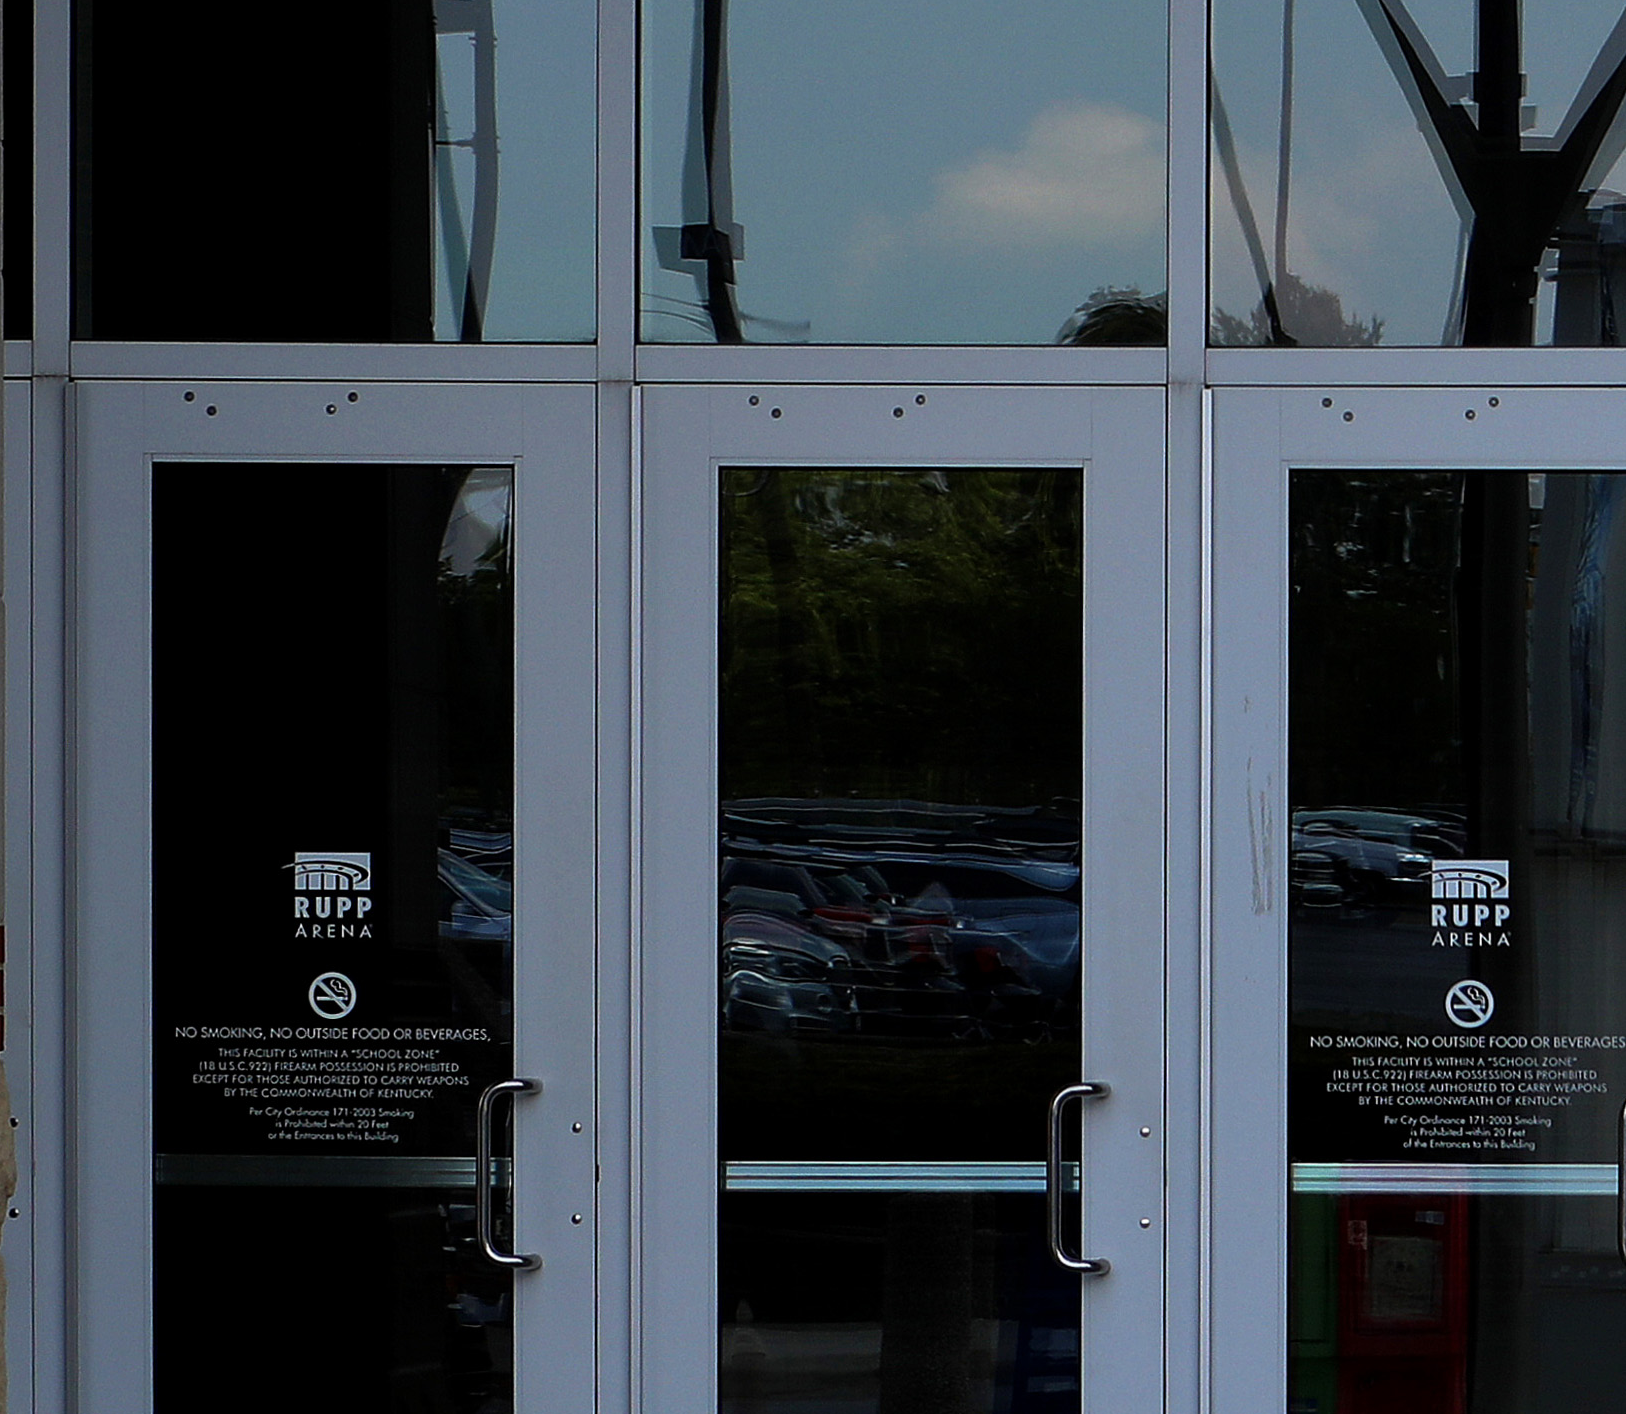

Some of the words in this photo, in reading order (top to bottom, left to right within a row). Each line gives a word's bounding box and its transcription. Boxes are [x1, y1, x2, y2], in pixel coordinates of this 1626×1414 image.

[295, 897, 371, 918] RUPP
[1432, 905, 1510, 926] RUPP
[295, 923, 372, 938] ARENA
[1432, 931, 1510, 946] ARENA
[175, 1026, 198, 1039] NO
[200, 1026, 267, 1041] SMOKING,
[269, 1026, 293, 1040] NO
[295, 1027, 349, 1040] OUTSIDE
[351, 1027, 391, 1041] FOOD
[392, 1027, 413, 1041] OR
[415, 1027, 492, 1042] BEVERAGES,
[1309, 1035, 1333, 1049] NO
[1335, 1035, 1403, 1050] SMOKING,
[1406, 1035, 1430, 1049] NO
[1431, 1035, 1486, 1049] OUTSIDE
[1489, 1035, 1528, 1049] FOOD
[1530, 1035, 1551, 1049] OR
[218, 1047, 241, 1058] THIS
[242, 1047, 287, 1059] FACILITY
[288, 1048, 298, 1059] IS
[299, 1048, 339, 1059] WITHIN
[340, 1049, 349, 1059] A
[350, 1048, 403, 1060] "SCHOOL
[404, 1048, 440, 1060] ZONE"
[199, 1060, 216, 1072] (18
[274, 1061, 318, 1072] FIREARM
[319, 1061, 385, 1073] POSSESSION
[386, 1062, 397, 1073] IS
[397, 1062, 460, 1073] PROHIBITED
[1351, 1056, 1375, 1067] THIS
[1377, 1056, 1421, 1067] FACILITY
[1422, 1056, 1434, 1068] IS
[1434, 1056, 1475, 1067] WITHIN
[1476, 1057, 1486, 1067] A
[1487, 1056, 1540, 1068] "SCHOOL
[1541, 1056, 1578, 1068] ZONE"
[192, 1073, 230, 1084] EXCEPT
[231, 1073, 254, 1085] FOR
[255, 1074, 291, 1085] THOSE
[292, 1074, 361, 1085] AUTHORIZED
[362, 1074, 378, 1086] TO
[380, 1075, 415, 1086] CARRY
[415, 1075, 470, 1086] WEAPONS
[1332, 1069, 1350, 1081] (18
[1409, 1069, 1453, 1080] FIREARM
[1455, 1069, 1522, 1080] POSSESSION
[1524, 1069, 1534, 1080] IS
[1536, 1069, 1597, 1080] PROHIBITED
[223, 1087, 237, 1097] BY
[239, 1087, 259, 1098] THE
[260, 1087, 357, 1099] COMMONWEALTH
[359, 1088, 375, 1099] OF
[1326, 1082, 1364, 1093] EXCEPT
[1366, 1082, 1389, 1093] FOR
[1390, 1082, 1426, 1093] THOSE
[1428, 1082, 1498, 1093] AUTHORIZED
[1499, 1082, 1516, 1093] TO
[1517, 1082, 1552, 1093] CARRY
[1553, 1082, 1608, 1093] WEAPONS
[1358, 1095, 1372, 1106] BY
[1374, 1095, 1394, 1106] THE
[1396, 1095, 1494, 1106] COMMONWEALTH
[1496, 1095, 1512, 1106] OF
[248, 1106, 264, 1117] Per
[264, 1106, 283, 1120] City
[283, 1106, 331, 1118] Ordinance
[332, 1107, 377, 1118] 171-2003
[378, 1107, 415, 1120] Smoking
[274, 1118, 283, 1129] is
[284, 1118, 328, 1129] Prohibited
[329, 1118, 356, 1129] within
[357, 1119, 370, 1130] 20
[371, 1119, 390, 1129] Feet
[1383, 1114, 1399, 1126] Per
[1399, 1114, 1418, 1128] City
[1418, 1114, 1467, 1126] Ordinance
[1468, 1115, 1513, 1126] 171-2003
[1514, 1115, 1552, 1128] Smoking
[1413, 1138, 1428, 1149] the
[1429, 1138, 1471, 1149] Entrances
[1482, 1138, 1499, 1149] this
[1500, 1138, 1536, 1152] Building
